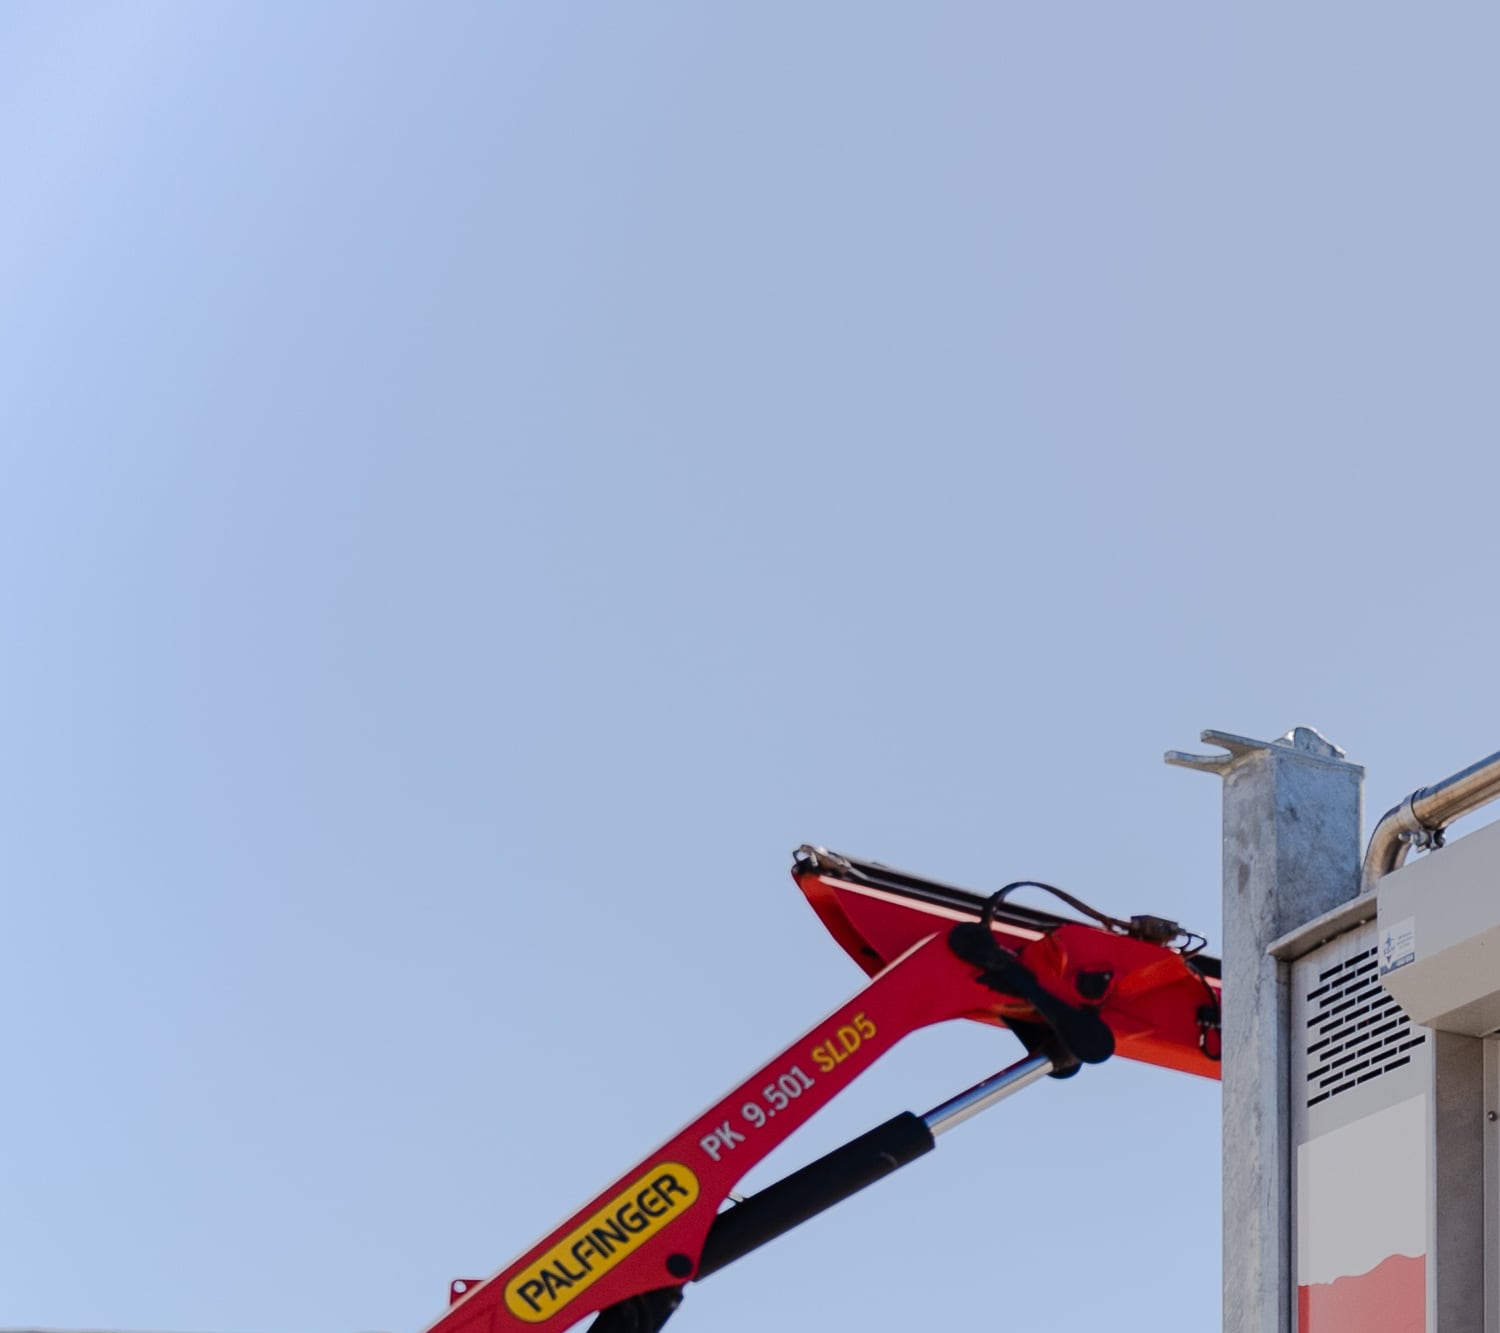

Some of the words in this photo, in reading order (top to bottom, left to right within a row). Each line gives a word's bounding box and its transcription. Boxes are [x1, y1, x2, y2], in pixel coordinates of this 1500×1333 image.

[699, 1120, 745, 1161] PK
[742, 1064, 816, 1128] 9.501
[811, 1012, 878, 1073] SLD5
[516, 1171, 690, 1313] PALFINGER
